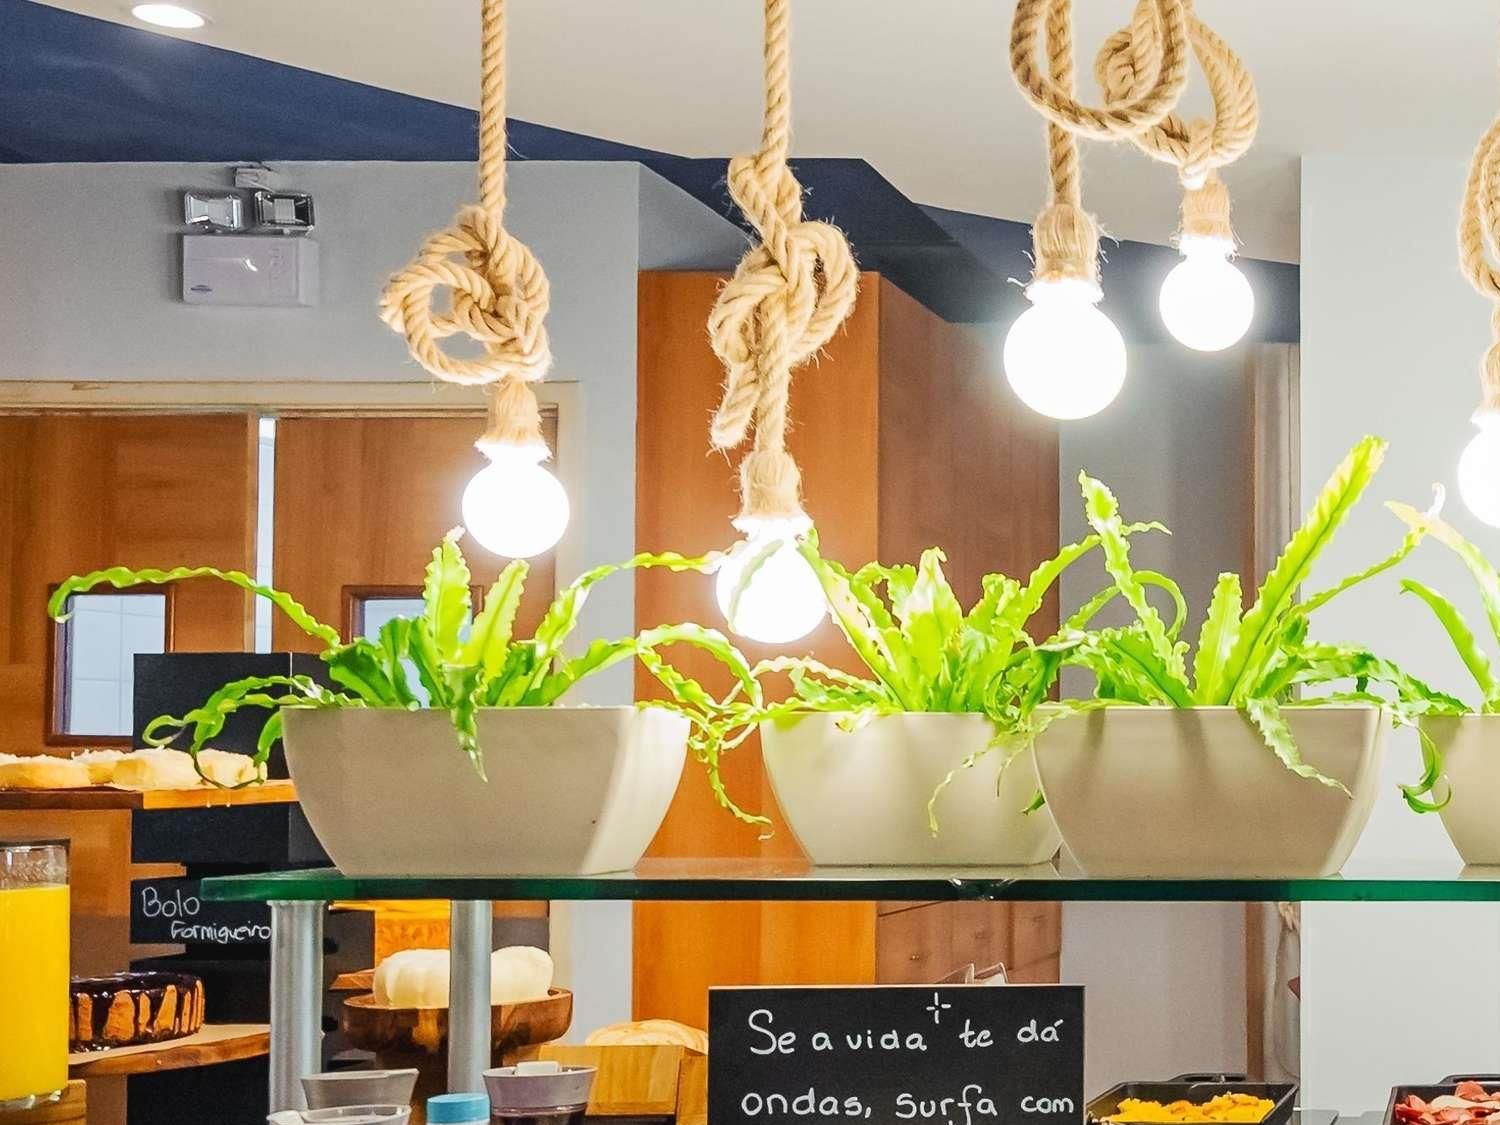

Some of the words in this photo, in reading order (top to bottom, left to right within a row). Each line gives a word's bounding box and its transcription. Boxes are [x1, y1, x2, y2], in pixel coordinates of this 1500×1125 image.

[141, 886, 200, 917] Bolo
[748, 1008, 796, 1055] Se
[811, 1032, 834, 1052] a
[845, 1029, 928, 1052] vida
[958, 1018, 994, 1048] te
[1016, 1018, 1064, 1043] dá
[740, 1087, 872, 1120] ondas,
[1020, 1095, 1074, 1114] com
